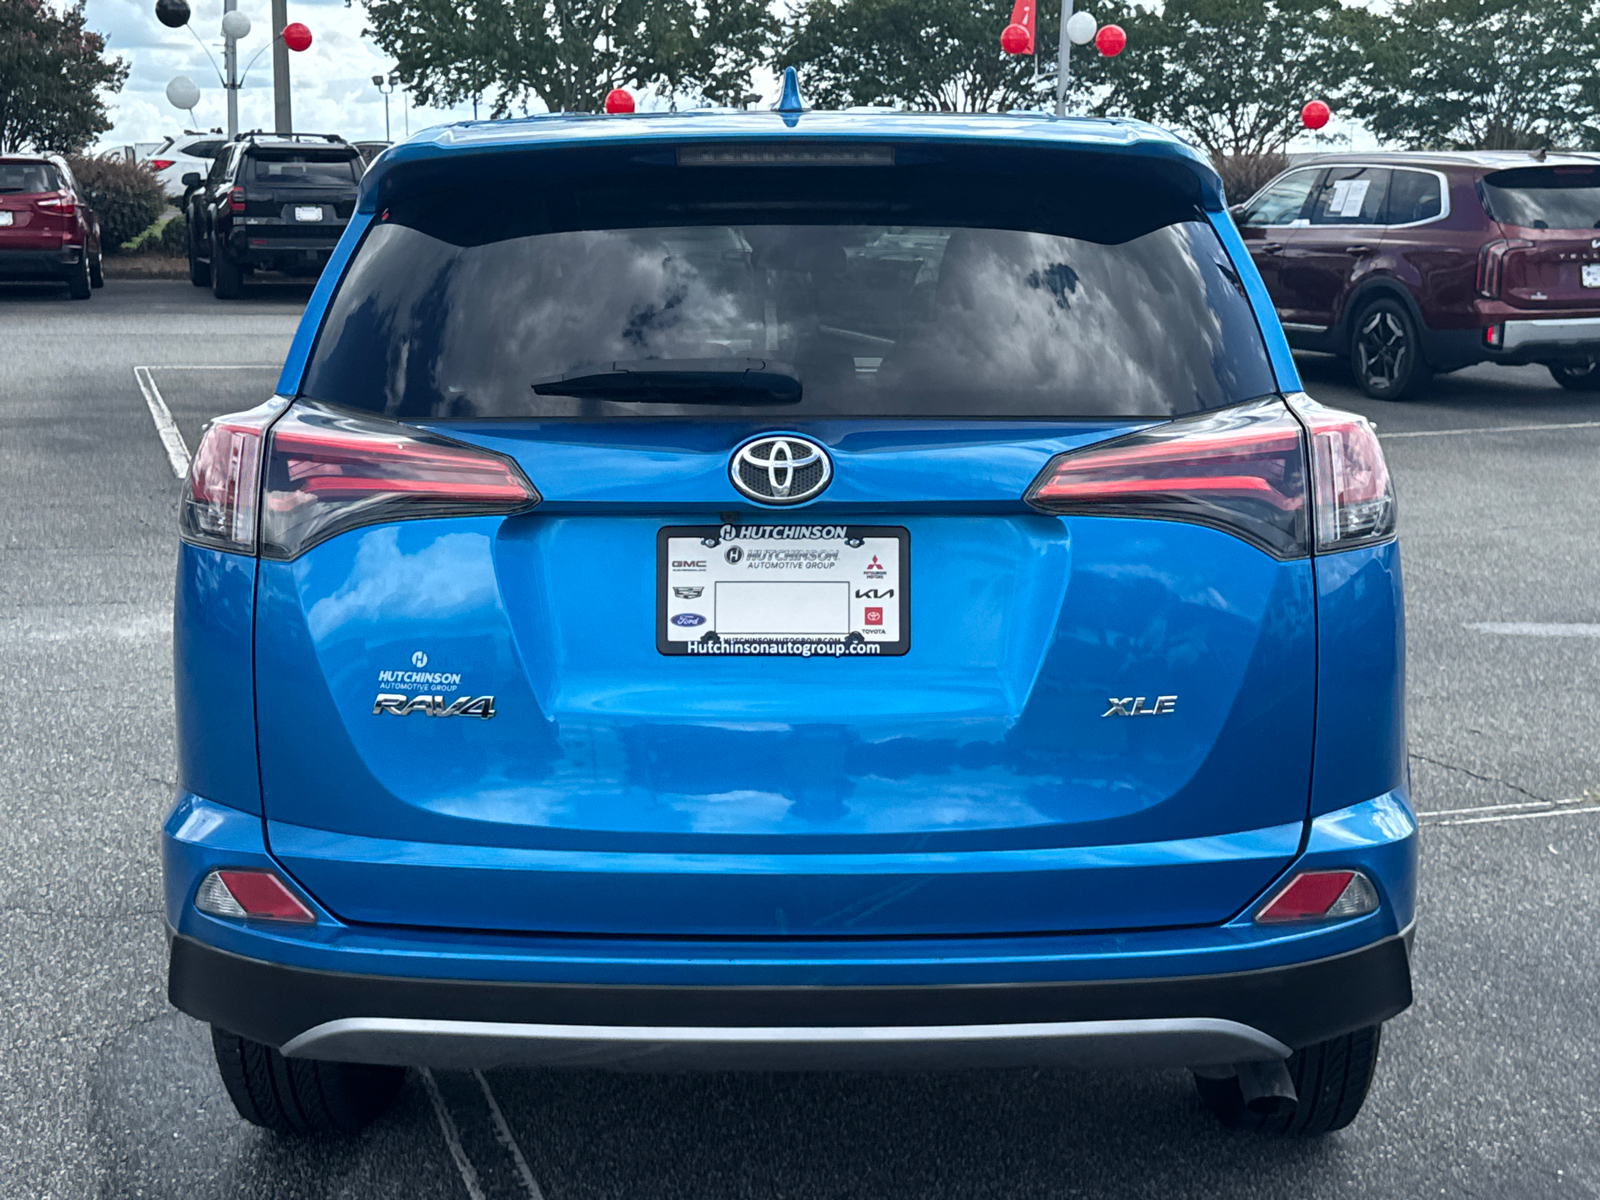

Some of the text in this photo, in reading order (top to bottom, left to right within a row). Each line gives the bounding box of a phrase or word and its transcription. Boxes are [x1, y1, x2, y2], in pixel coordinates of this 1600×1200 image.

[740, 525, 847, 539] HUTCHINSON
[746, 549, 839, 561] HUTCHINSON
[671, 560, 707, 568] GMC
[747, 561, 835, 569] AUTOMOTIVE GROUP
[677, 615, 700, 625] Ford
[687, 641, 881, 657] Hutchinsonautogroup.com
[378, 670, 461, 684] HUTCHINSON
[379, 682, 429, 691] AUTOMOTIVE
[372, 693, 496, 720] RAV4
[1100, 695, 1178, 717] XLE
